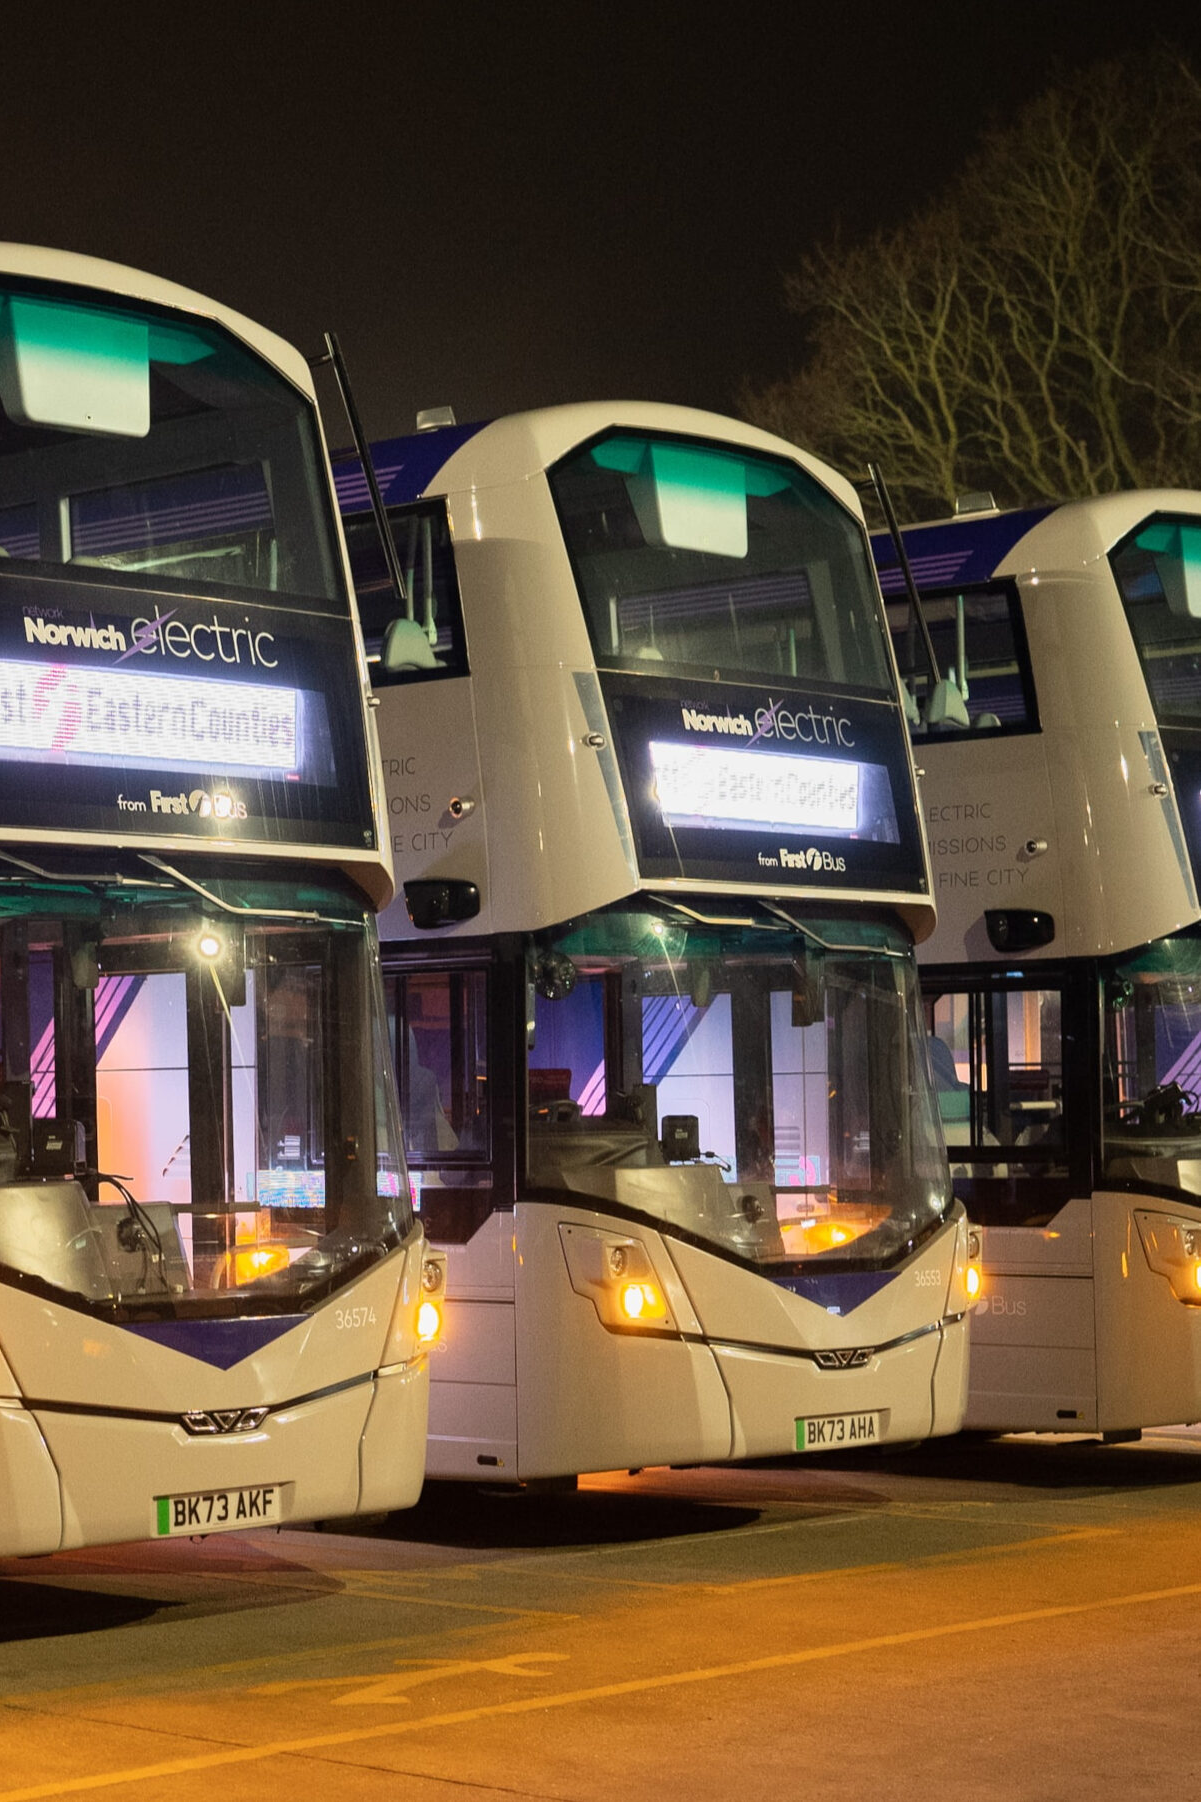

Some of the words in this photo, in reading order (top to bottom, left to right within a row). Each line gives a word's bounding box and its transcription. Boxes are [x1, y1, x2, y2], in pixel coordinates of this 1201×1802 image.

[22, 604, 64, 619] network
[24, 616, 127, 652] Norwich
[131, 605, 279, 668] electric
[681, 708, 754, 737] Norwich
[753, 697, 856, 748] electric
[117, 793, 147, 813] from
[150, 790, 190, 815] First
[926, 802, 992, 823] ECTRIC
[412, 831, 454, 852] CITY
[928, 835, 1007, 856] ISSIONS
[758, 852, 779, 868] from
[779, 848, 807, 870] First
[822, 854, 846, 872] Bus
[939, 871, 980, 888] FINE
[986, 867, 1030, 886] CITY
[335, 1306, 377, 1329] 36574
[991, 1296, 1028, 1316] Bus
[807, 1418, 845, 1444] BK73
[849, 1415, 875, 1440] AHA
[174, 1493, 229, 1527] BK73
[236, 1488, 274, 1520] AKF
